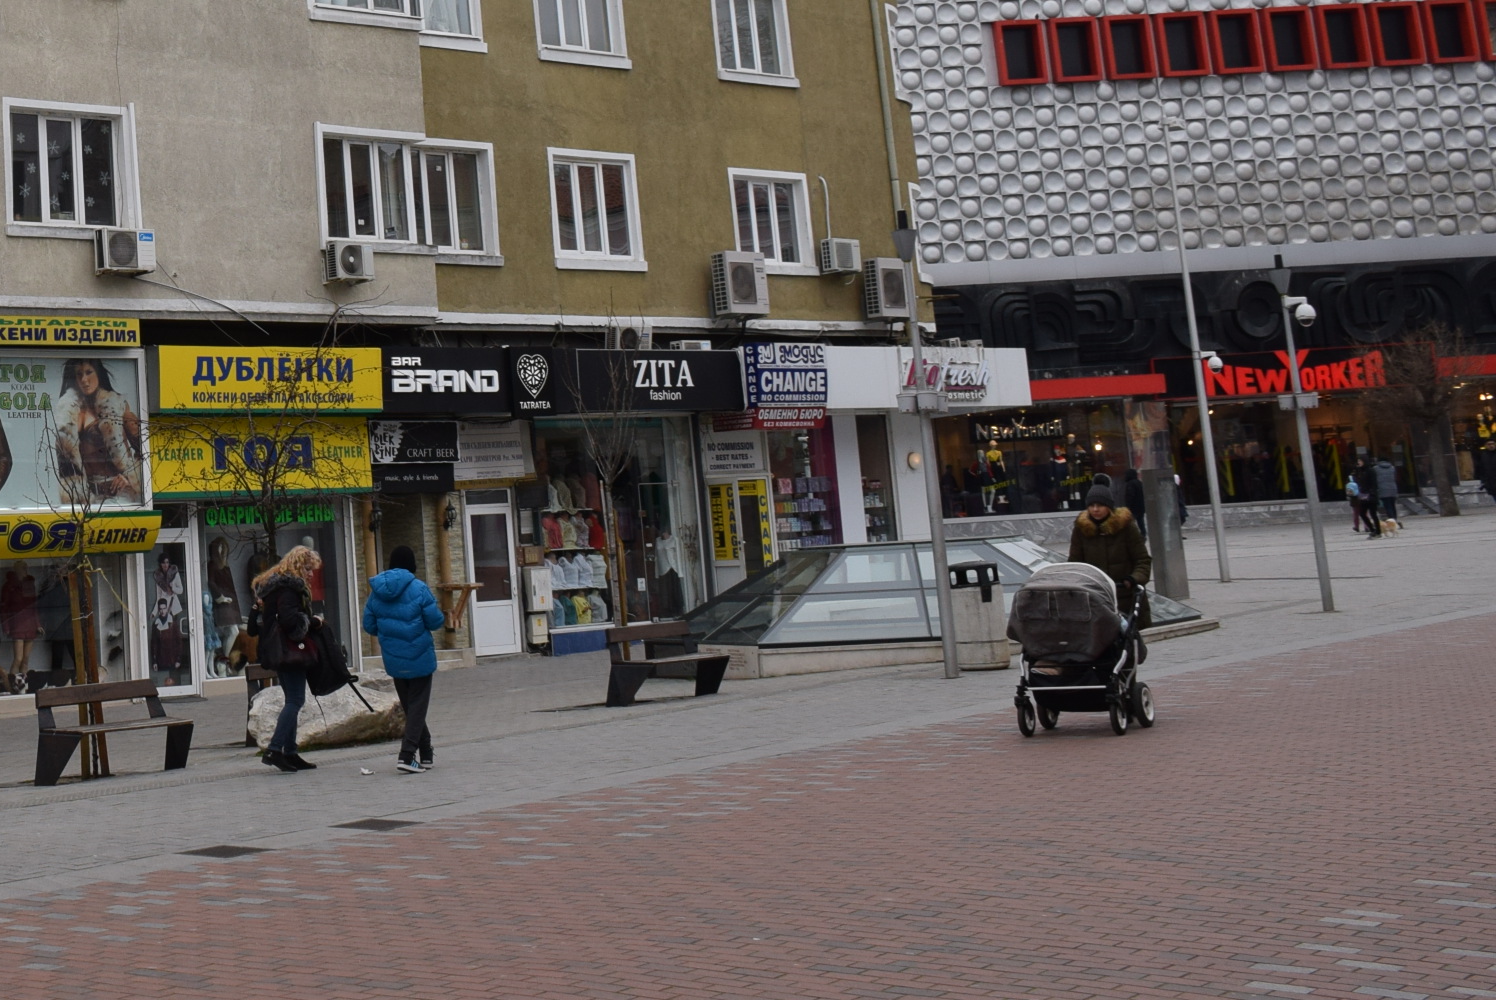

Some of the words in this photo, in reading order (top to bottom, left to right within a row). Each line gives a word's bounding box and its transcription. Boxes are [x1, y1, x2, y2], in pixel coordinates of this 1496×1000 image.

[54, 327, 137, 343] ИЗДЕЛИЯ
[391, 357, 421, 366] BAR
[0, 363, 47, 383] ГОЯ
[633, 359, 695, 387] ZITA
[746, 346, 757, 403] CHANGE
[1202, 359, 1288, 396] NEW
[1274, 348, 1386, 391] YORKER
[10, 383, 35, 391] КОЖИ
[391, 369, 500, 393] BRAND
[761, 371, 826, 392] CHANGE
[192, 392, 237, 403] КОЖЕНИ
[649, 389, 682, 400] fashion
[947, 390, 985, 399] osmetic
[519, 401, 551, 409] TATRATEA
[7, 411, 42, 419] LEATHER
[758, 409, 798, 419] ОБМЕННО
[800, 409, 824, 419] БЮРО
[976, 423, 1013, 439] NEW
[211, 432, 316, 474] ГОЯ
[321, 445, 363, 458] LEATHER
[407, 448, 434, 458] CRAFT
[436, 448, 454, 457] BEER
[707, 443, 716, 451] NO
[717, 442, 754, 450] COMMISSION
[157, 448, 204, 461] LEATHER
[88, 527, 148, 545] LEATHER
[759, 495, 772, 568] CHANG
